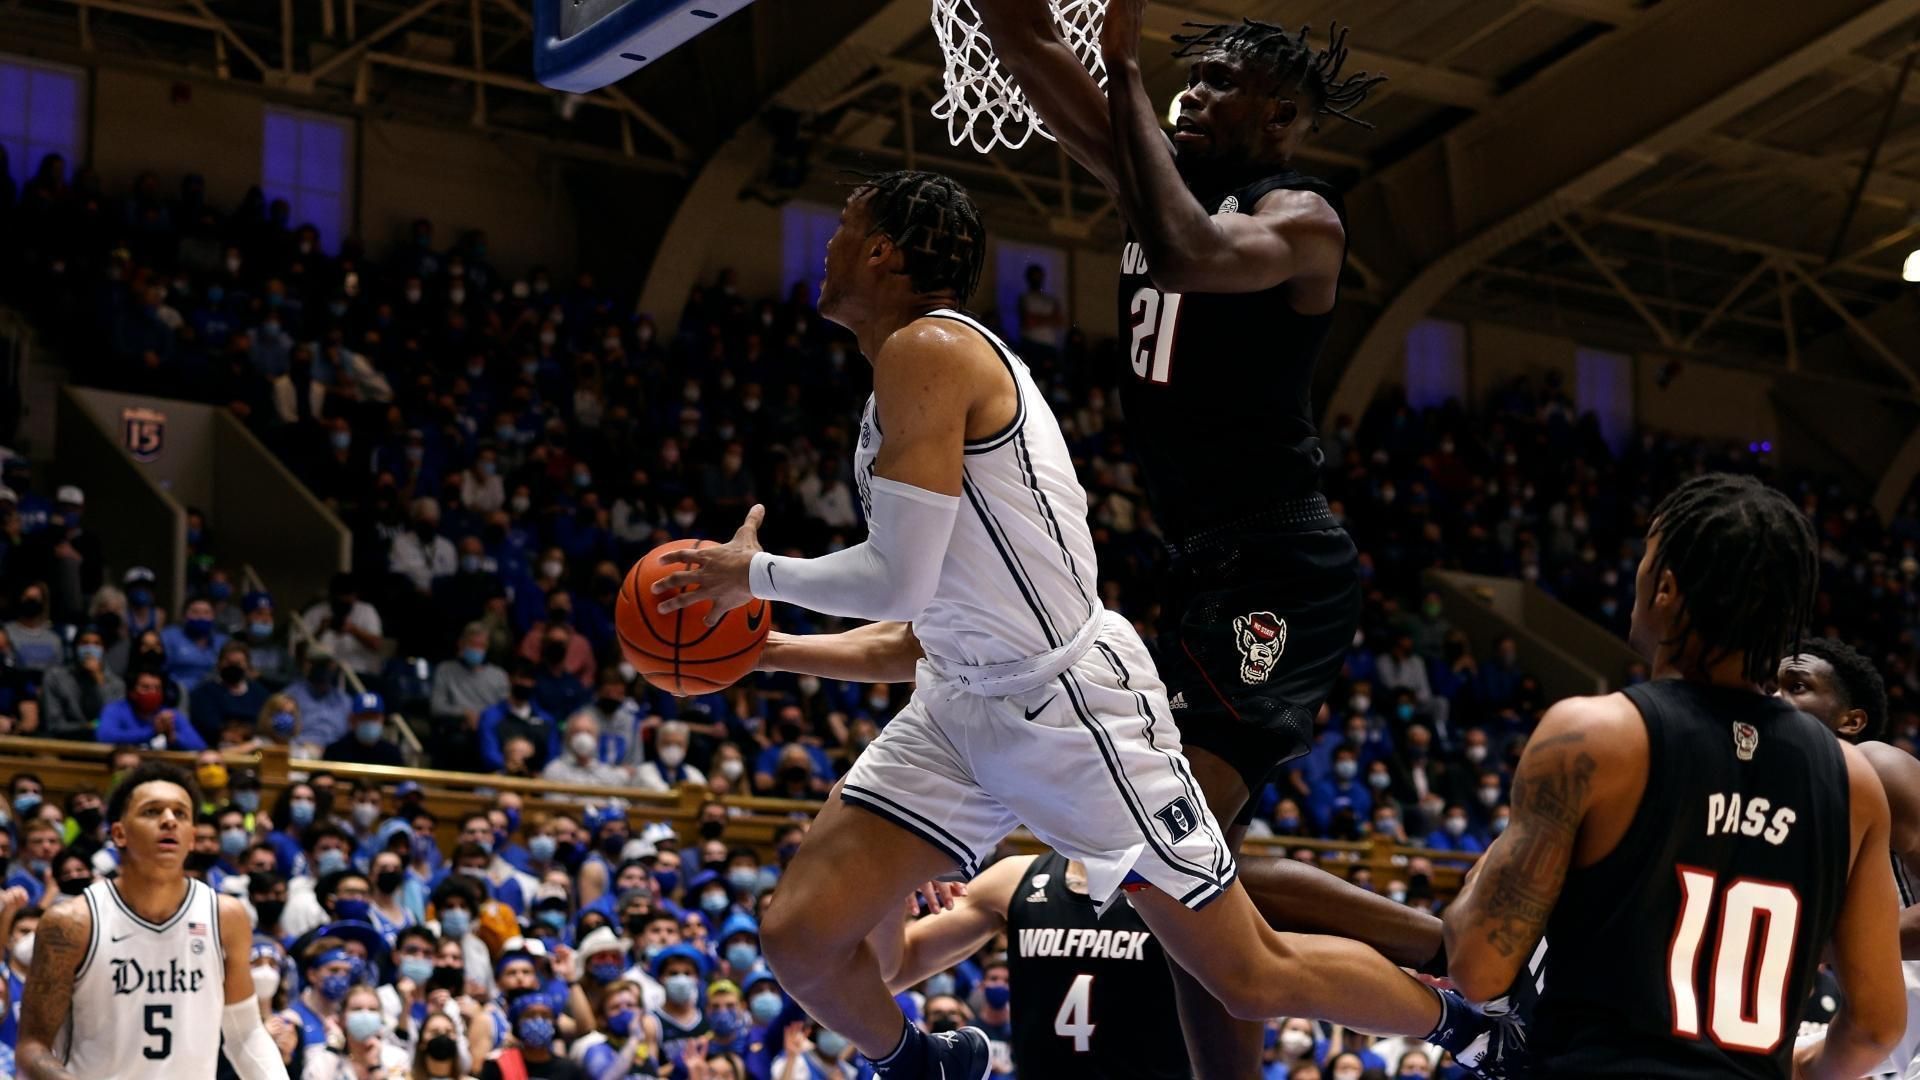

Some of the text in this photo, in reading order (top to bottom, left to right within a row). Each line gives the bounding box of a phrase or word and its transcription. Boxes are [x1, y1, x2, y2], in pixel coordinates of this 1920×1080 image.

[1130, 286, 1183, 386] 21
[129, 421, 161, 451] 15
[1705, 792, 1797, 846] PASS
[1018, 927, 1151, 961] WOLFPACK
[1667, 864, 1802, 1055] 10
[110, 957, 204, 995] Duke
[143, 1004, 173, 1060] 5
[1053, 973, 1097, 1053] 4
